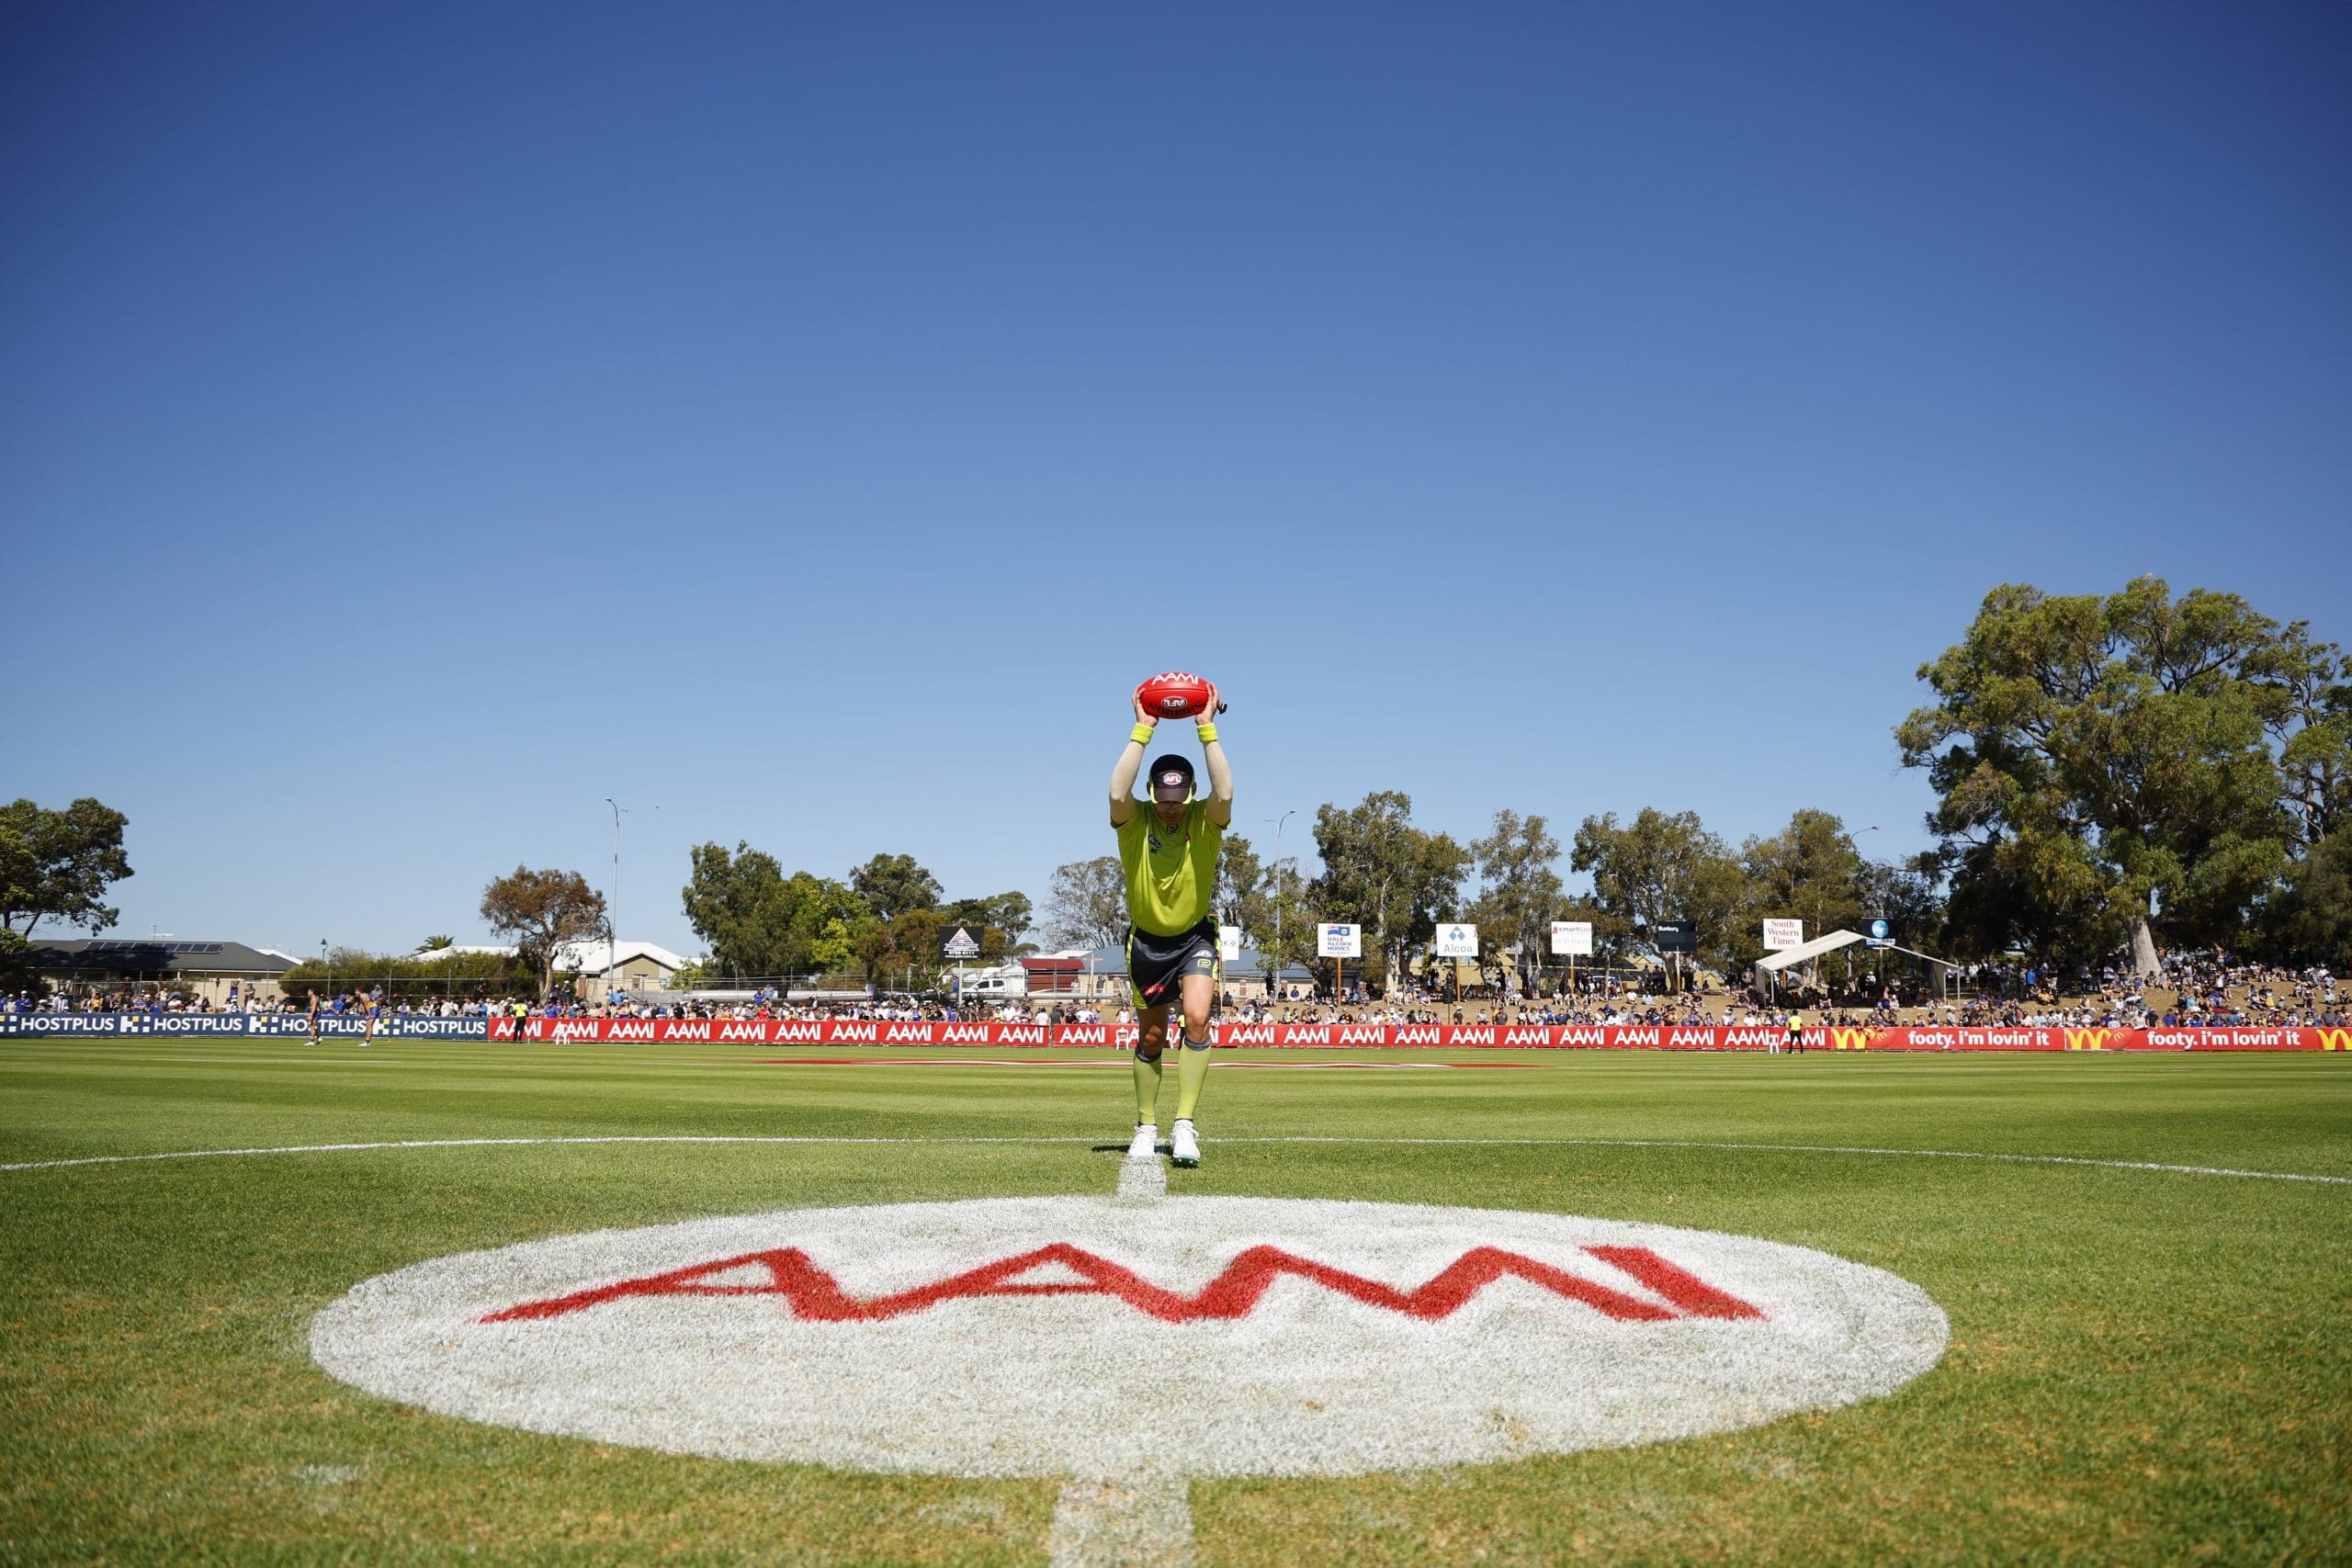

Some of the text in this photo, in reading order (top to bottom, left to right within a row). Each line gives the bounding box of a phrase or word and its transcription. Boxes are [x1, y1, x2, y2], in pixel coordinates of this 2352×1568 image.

[1151, 672, 1199, 685] AAMI
[1163, 699, 1186, 707] AFL
[1770, 919, 1794, 928] South
[1767, 928, 1800, 936] Western
[1770, 936, 1796, 944] Times
[1443, 943, 1473, 953] Alcoa
[20, 1017, 115, 1032] HOSTPLUS
[153, 1017, 243, 1032] HOSTPLUS
[281, 1018, 368, 1032] HOTPLUS
[403, 1019, 486, 1034] HOSTPLUS
[607, 1021, 655, 1039] AAMI
[663, 1022, 711, 1039] AAMI
[719, 1023, 766, 1040] AAMI
[775, 1023, 821, 1040] AAMI
[830, 1023, 876, 1040] AAMI
[886, 1024, 932, 1041] AAMI
[942, 1025, 989, 1042] AAMI
[998, 1026, 1045, 1043] AAMI
[1059, 1026, 1105, 1043] AAMI
[1228, 1027, 1274, 1043] AAMI
[1284, 1027, 1329, 1043] AAMI
[1340, 1027, 1385, 1043] AAMI
[1395, 1028, 1441, 1044] AAMI
[1450, 1028, 1495, 1044] AAMI
[1505, 1028, 1550, 1044] AAMI
[1559, 1029, 1605, 1045] AAMI
[1614, 1029, 1659, 1045] AAMI
[1669, 1029, 1714, 1045] AAMI
[1724, 1029, 1770, 1045] AAMI
[1908, 1030, 2050, 1049] footy. i'm lovin' it
[2147, 1030, 2301, 1049] footy. i'm lovin' it
[476, 1243, 1762, 1323] AAMI
